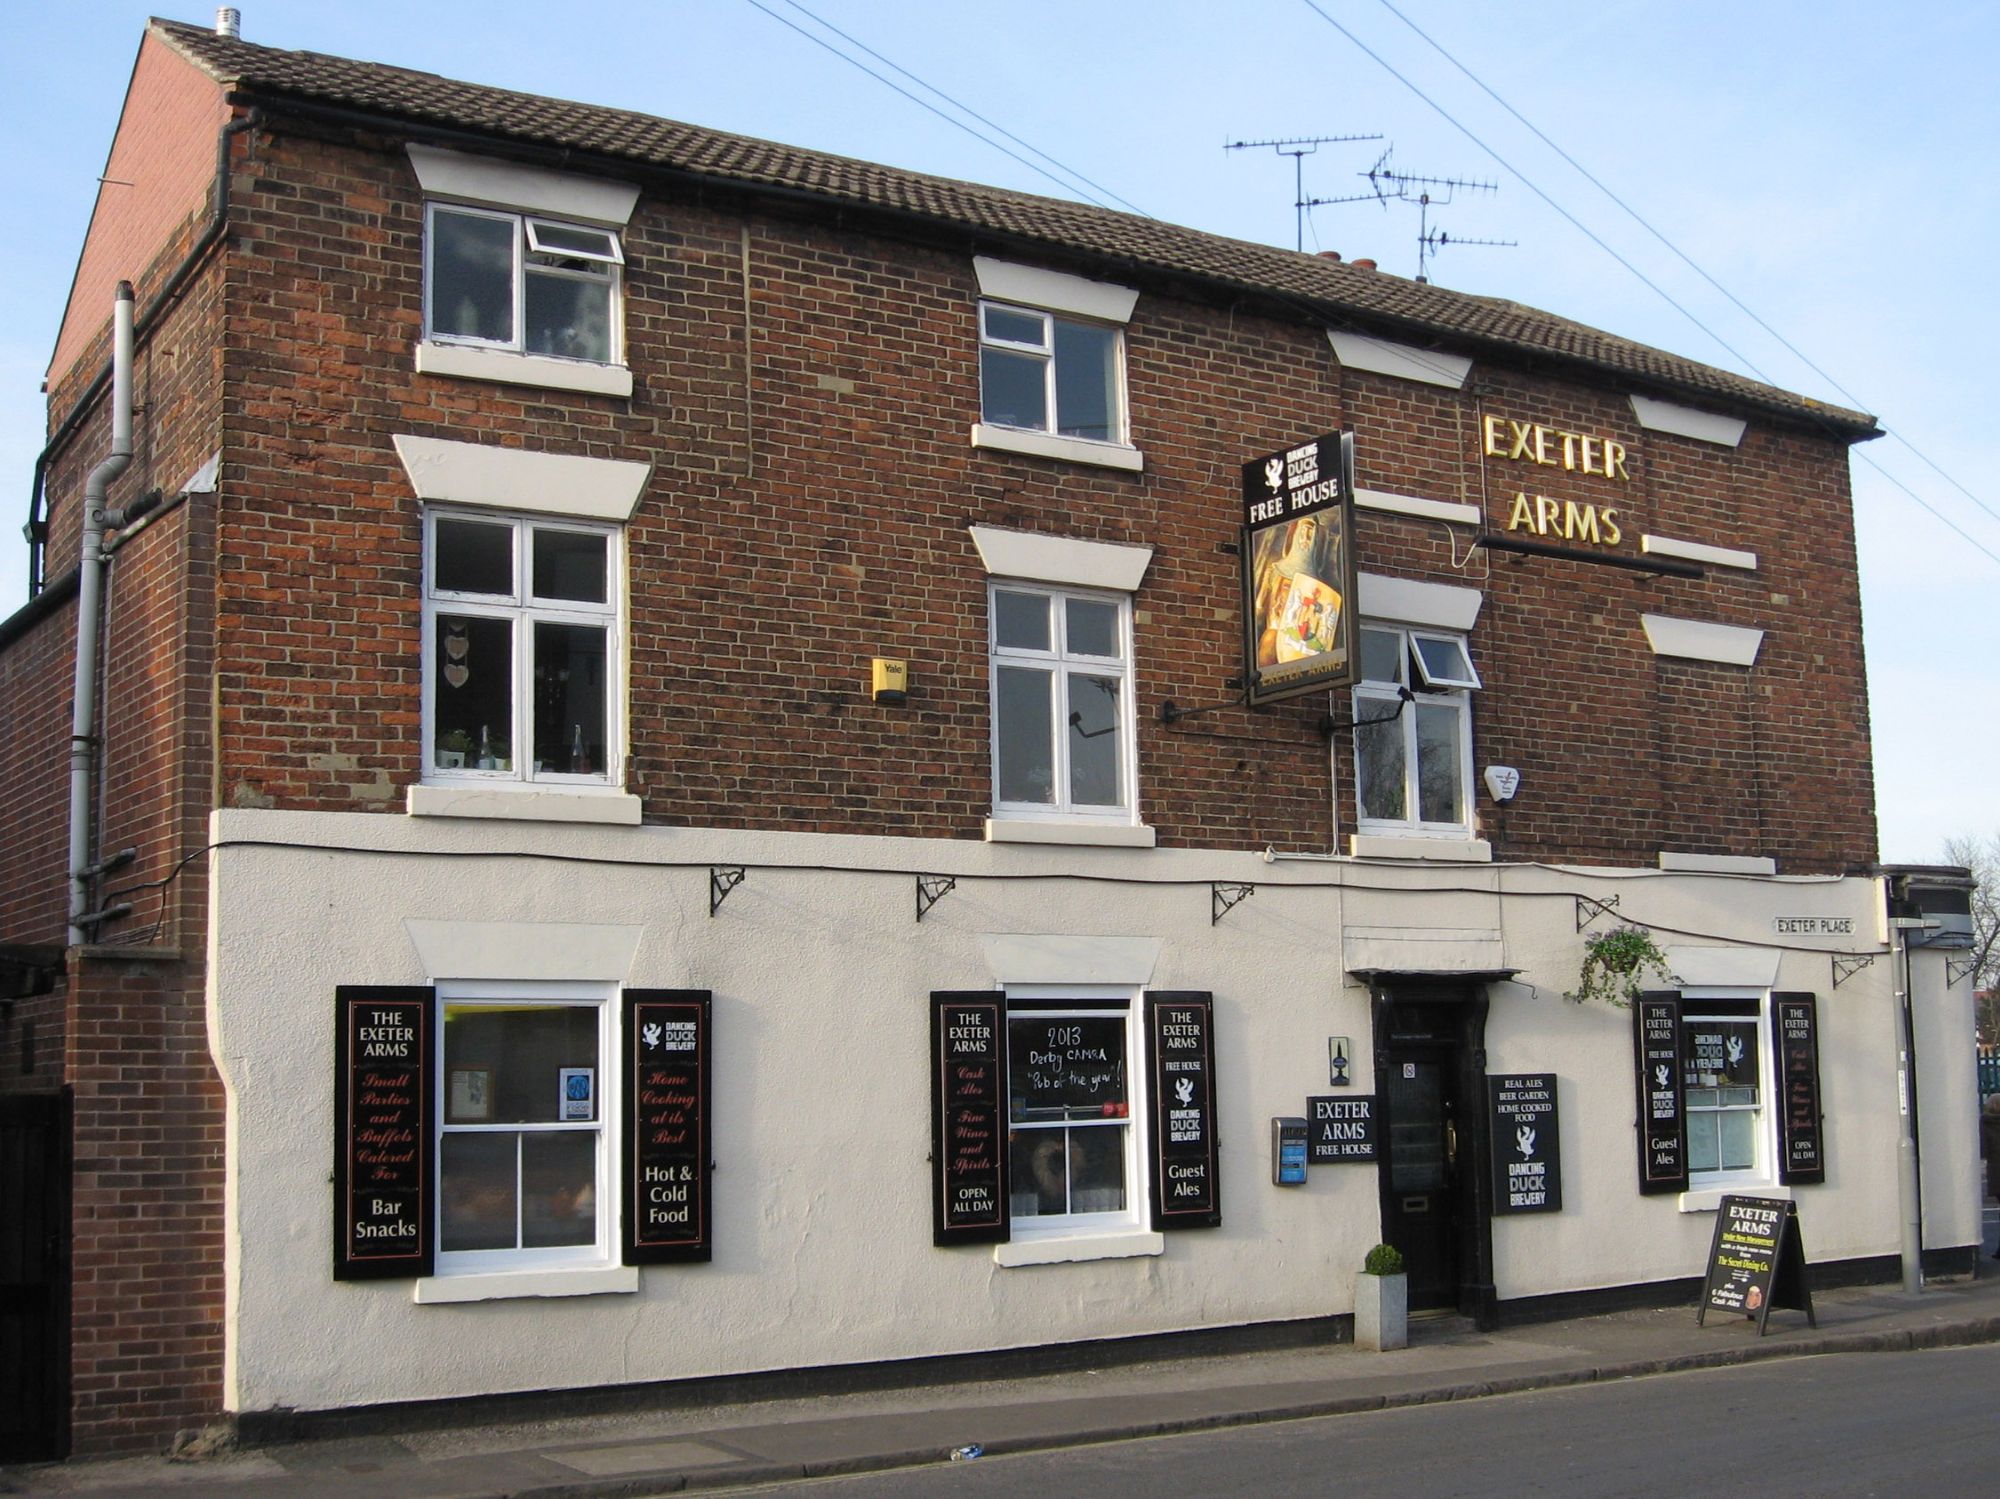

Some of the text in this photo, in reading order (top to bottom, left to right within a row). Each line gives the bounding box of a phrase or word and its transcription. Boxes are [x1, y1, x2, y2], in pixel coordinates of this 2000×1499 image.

[1286, 443, 1318, 463] DANCING
[1485, 414, 1630, 481] EXETER
[1287, 455, 1318, 477] DUCK
[1287, 469, 1319, 490] BREWERY
[1250, 478, 1338, 524] FREE HOUSE
[1508, 491, 1621, 546] ARMS
[885, 663, 902, 674] Yale
[1261, 656, 1342, 687] EXETER ARMS
[1778, 919, 1851, 933] EXETER PLACE
[371, 1012, 402, 1025] THE
[958, 1013, 982, 1025] THE
[1170, 1012, 1192, 1023] THE
[1651, 1008, 1668, 1018] THE
[1789, 1009, 1804, 1018] THE
[665, 1021, 697, 1031] DANCING
[1163, 1024, 1201, 1036] EXETER
[1646, 1019, 1673, 1029] EXETER
[1785, 1019, 1809, 1029] EXETER
[360, 1028, 414, 1041] EXETER
[665, 1031, 696, 1041] DUCK
[949, 1027, 991, 1039] EXETER
[1047, 1026, 1081, 1047] 2013
[1649, 1029, 1671, 1040] ARMS
[1787, 1029, 1808, 1039] ARMS
[364, 1043, 408, 1056] ARMS
[665, 1041, 697, 1051] BREWERY
[953, 1040, 987, 1053] ARMS
[1167, 1037, 1197, 1049] ARMS
[1030, 1050, 1062, 1073] Derby
[1166, 1061, 1201, 1071] FREE HOUSE
[647, 1071, 688, 1085] Home
[957, 1065, 985, 1079] Cask
[1069, 1070, 1087, 1087] the
[362, 1074, 410, 1087] Small
[1505, 1078, 1543, 1089] REAL ALES
[957, 1082, 983, 1095] Ales
[360, 1091, 410, 1105] Parties
[641, 1090, 695, 1110] Cooking
[1499, 1090, 1549, 1101] BEER GARDEN
[1652, 1091, 1674, 1100] DANCING
[1316, 1101, 1370, 1119] EXETER
[1498, 1103, 1552, 1114] HOME COOKED
[1653, 1099, 1674, 1109] DUCK
[369, 1111, 401, 1123] and
[650, 1111, 685, 1124] at its
[958, 1110, 985, 1123] Fine
[1170, 1109, 1201, 1119] DANCING
[1515, 1113, 1536, 1122] FOOD
[1653, 1109, 1675, 1119] BREWERY
[1170, 1119, 1201, 1131] DUCK
[1322, 1122, 1365, 1140] ARMS
[357, 1129, 414, 1147] Buffets
[652, 1129, 686, 1144] Best
[956, 1126, 989, 1138] Wines
[1171, 1131, 1201, 1142] BREWERY
[960, 1142, 984, 1154] and
[1651, 1137, 1678, 1149] Guest
[1795, 1140, 1811, 1149] OPEN
[357, 1149, 415, 1162] Catered
[1316, 1144, 1373, 1156] FREE HOUSE
[1792, 1150, 1815, 1160] ALL DAY
[1656, 1152, 1674, 1165] Ales
[371, 1166, 400, 1179] For
[953, 1158, 990, 1175] Spirits
[1168, 1164, 1205, 1179] Guest
[1509, 1162, 1545, 1176] DANCING
[645, 1166, 693, 1182] Hot &
[1174, 1182, 1200, 1197] Ales
[1509, 1176, 1545, 1192] DUCK
[650, 1185, 687, 1202] Cold
[959, 1187, 988, 1199] OPEN
[1510, 1191, 1546, 1206] BREWERY
[372, 1199, 402, 1215] Bar
[953, 1200, 994, 1213] ALL DAY
[649, 1205, 689, 1224] Food
[1729, 1206, 1778, 1222] EXETER
[356, 1219, 417, 1238] Snacks
[1731, 1220, 1771, 1235] ARMS
[1718, 1255, 1728, 1265] The
